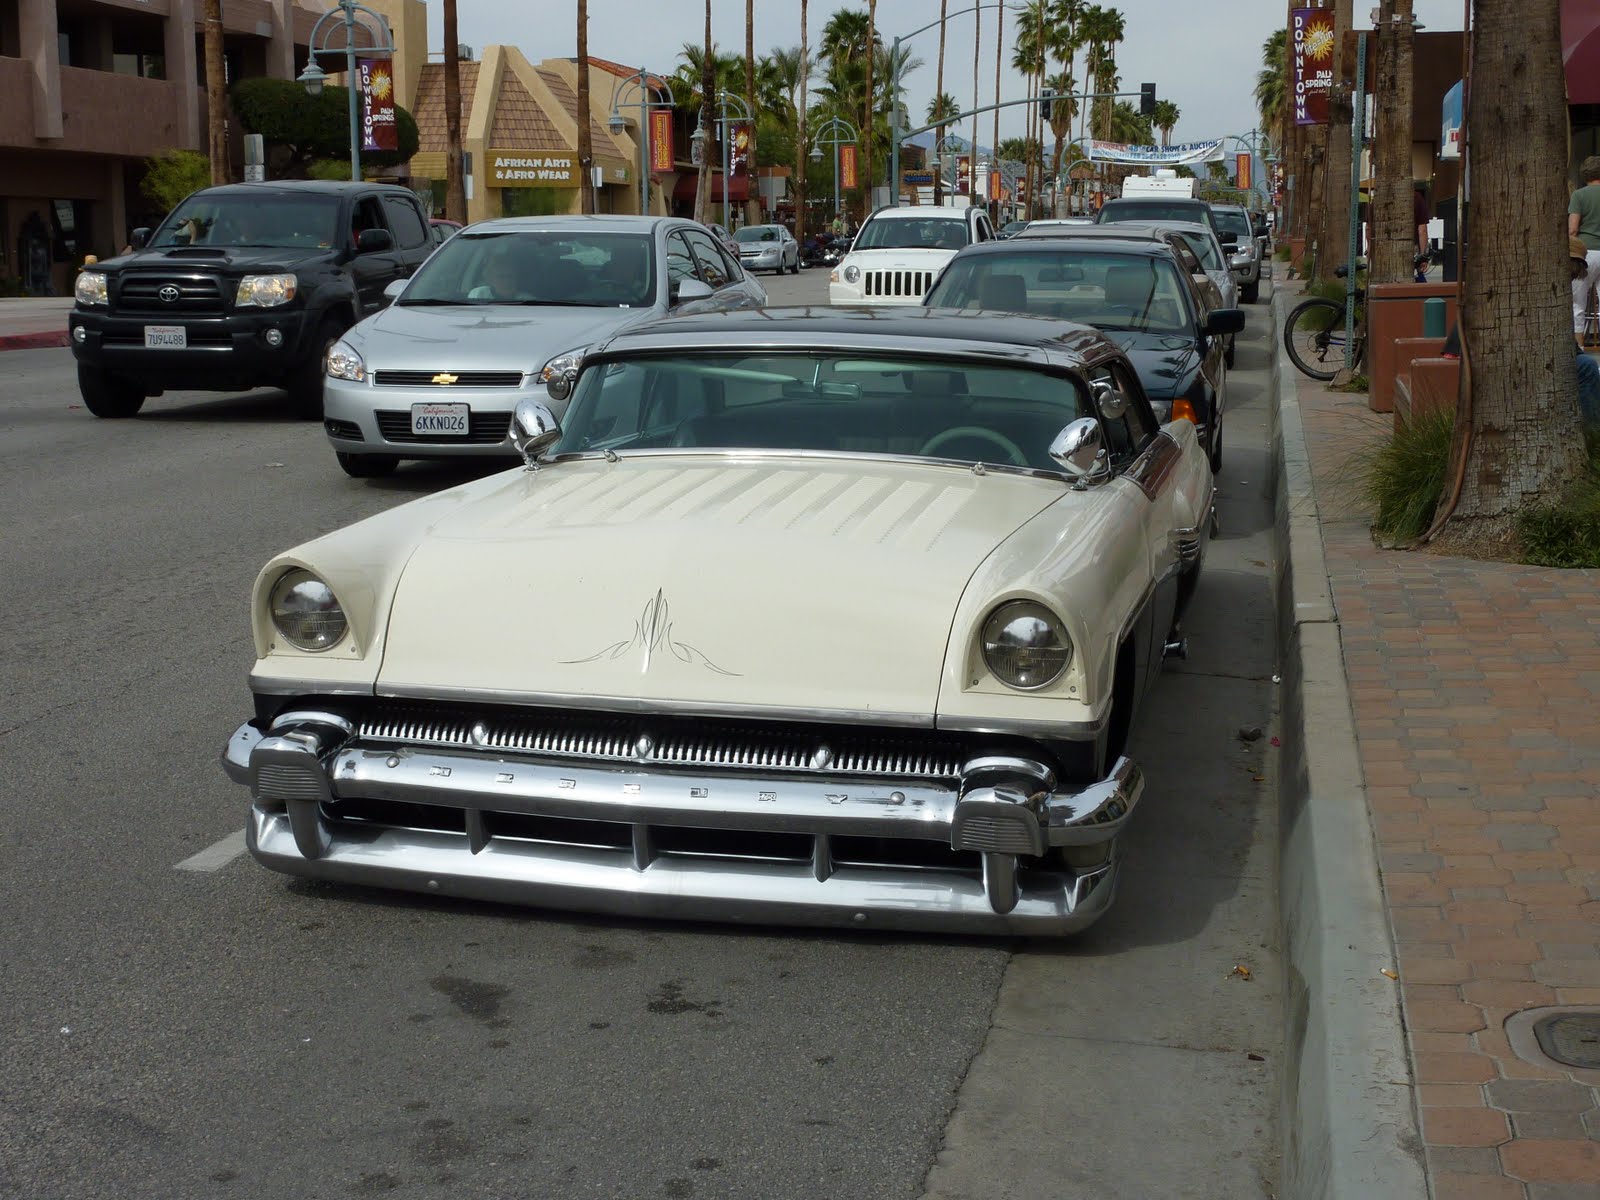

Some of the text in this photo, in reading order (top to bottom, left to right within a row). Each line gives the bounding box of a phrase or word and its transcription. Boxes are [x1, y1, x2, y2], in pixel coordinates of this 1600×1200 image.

[1294, 16, 1306, 119] DOWNTOWN
[1305, 78, 1332, 88] SPRING
[361, 64, 373, 146] DOWNTOWN
[380, 107, 394, 115] PALM
[372, 114, 395, 122] SPRINGS
[1146, 144, 1159, 153] CAR
[1161, 144, 1181, 153] SHOW
[1181, 143, 1187, 151] &
[1189, 140, 1218, 150] AUCTION
[495, 157, 571, 168] AFRICAN ARTS
[496, 169, 570, 180] & AFRO WEAR
[415, 416, 465, 430] 6KKN026
